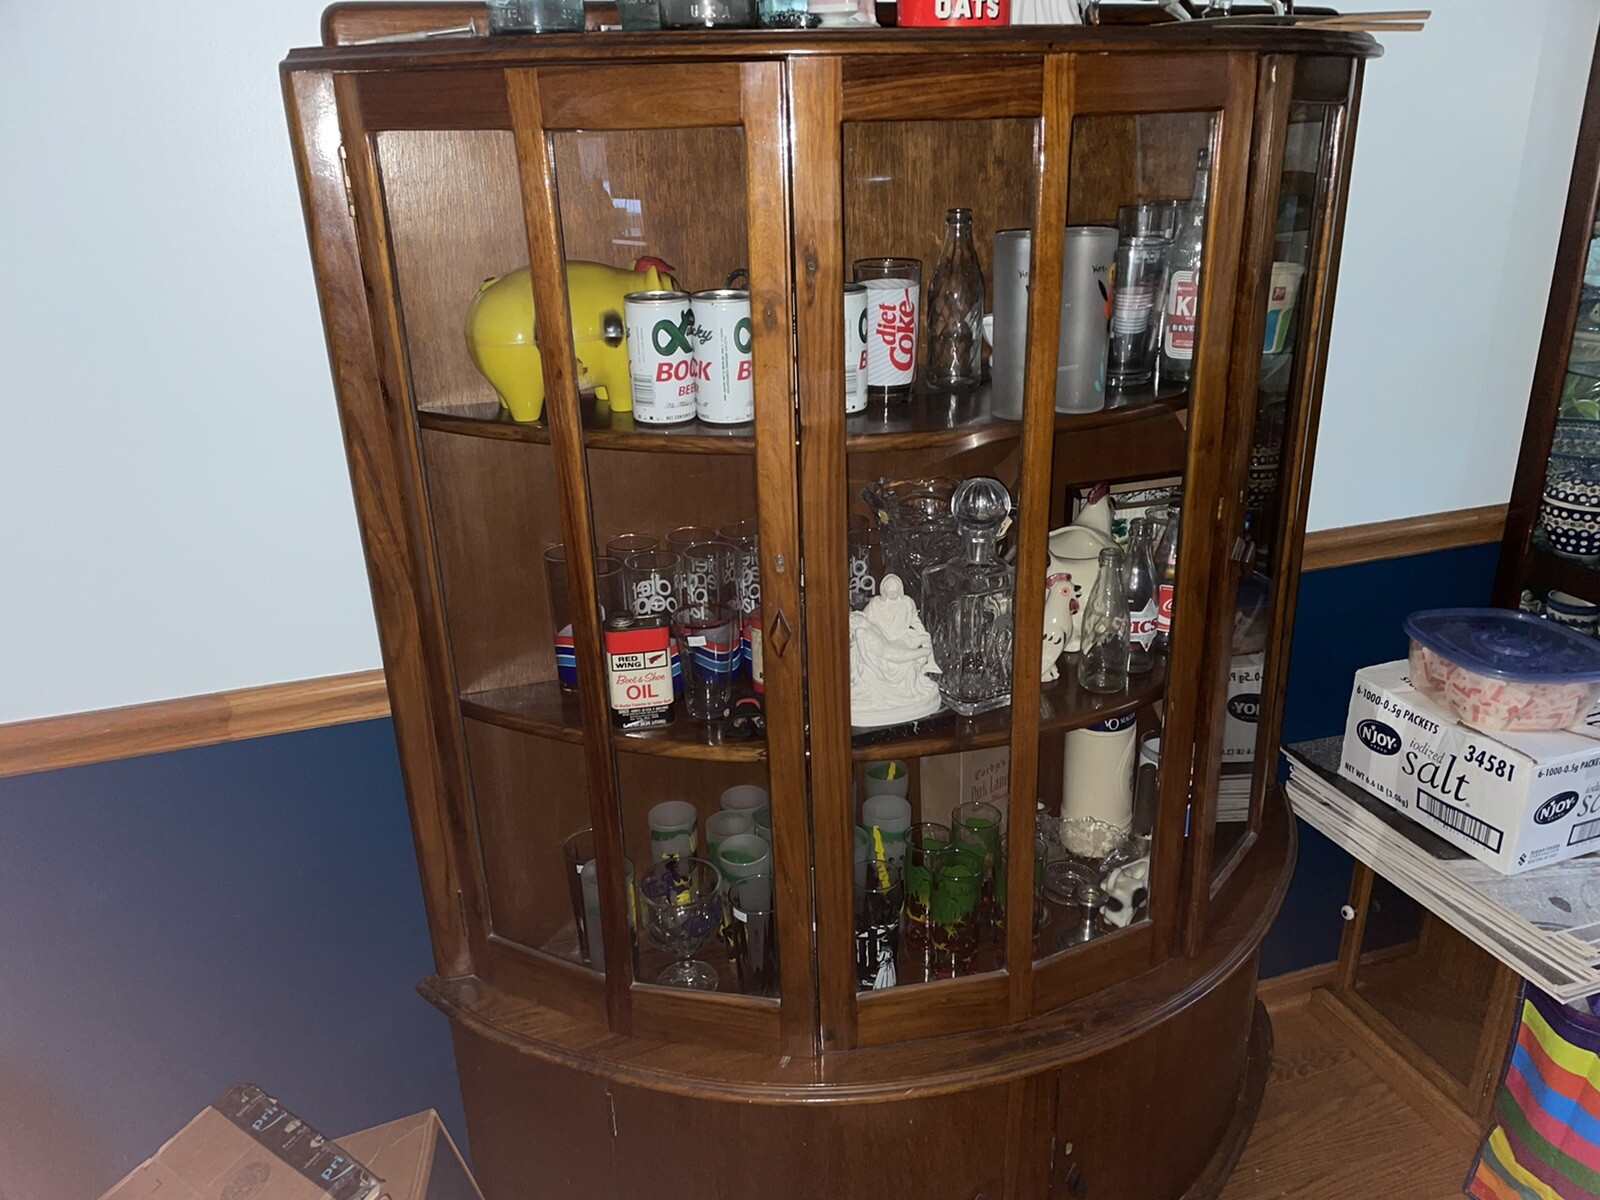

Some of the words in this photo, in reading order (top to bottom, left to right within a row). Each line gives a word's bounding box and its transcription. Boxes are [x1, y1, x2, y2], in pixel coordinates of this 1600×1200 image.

[935, 0, 1000, 19] OATS
[876, 303, 897, 346] diet
[889, 288, 916, 371] Coke
[1172, 323, 1195, 332] BEVE
[656, 359, 712, 382] BOCK
[615, 661, 641, 669] WING
[644, 671, 666, 682] Shoe
[626, 684, 659, 700] OIL
[1356, 685, 1402, 718] 6-1000-0.5g
[1403, 709, 1440, 734] PACKETS
[1409, 738, 1446, 764] iodized
[1464, 745, 1516, 782] 34581
[1402, 752, 1470, 801] salt
[1537, 763, 1579, 778] 6-1000-0.5g
[1345, 762, 1355, 774] NET
[1356, 769, 1365, 780] WT
[1366, 776, 1376, 787] 6.6
[1377, 783, 1384, 792] LB
[1386, 788, 1409, 809] (3.0kg)
[321, 1154, 345, 1181] pri
